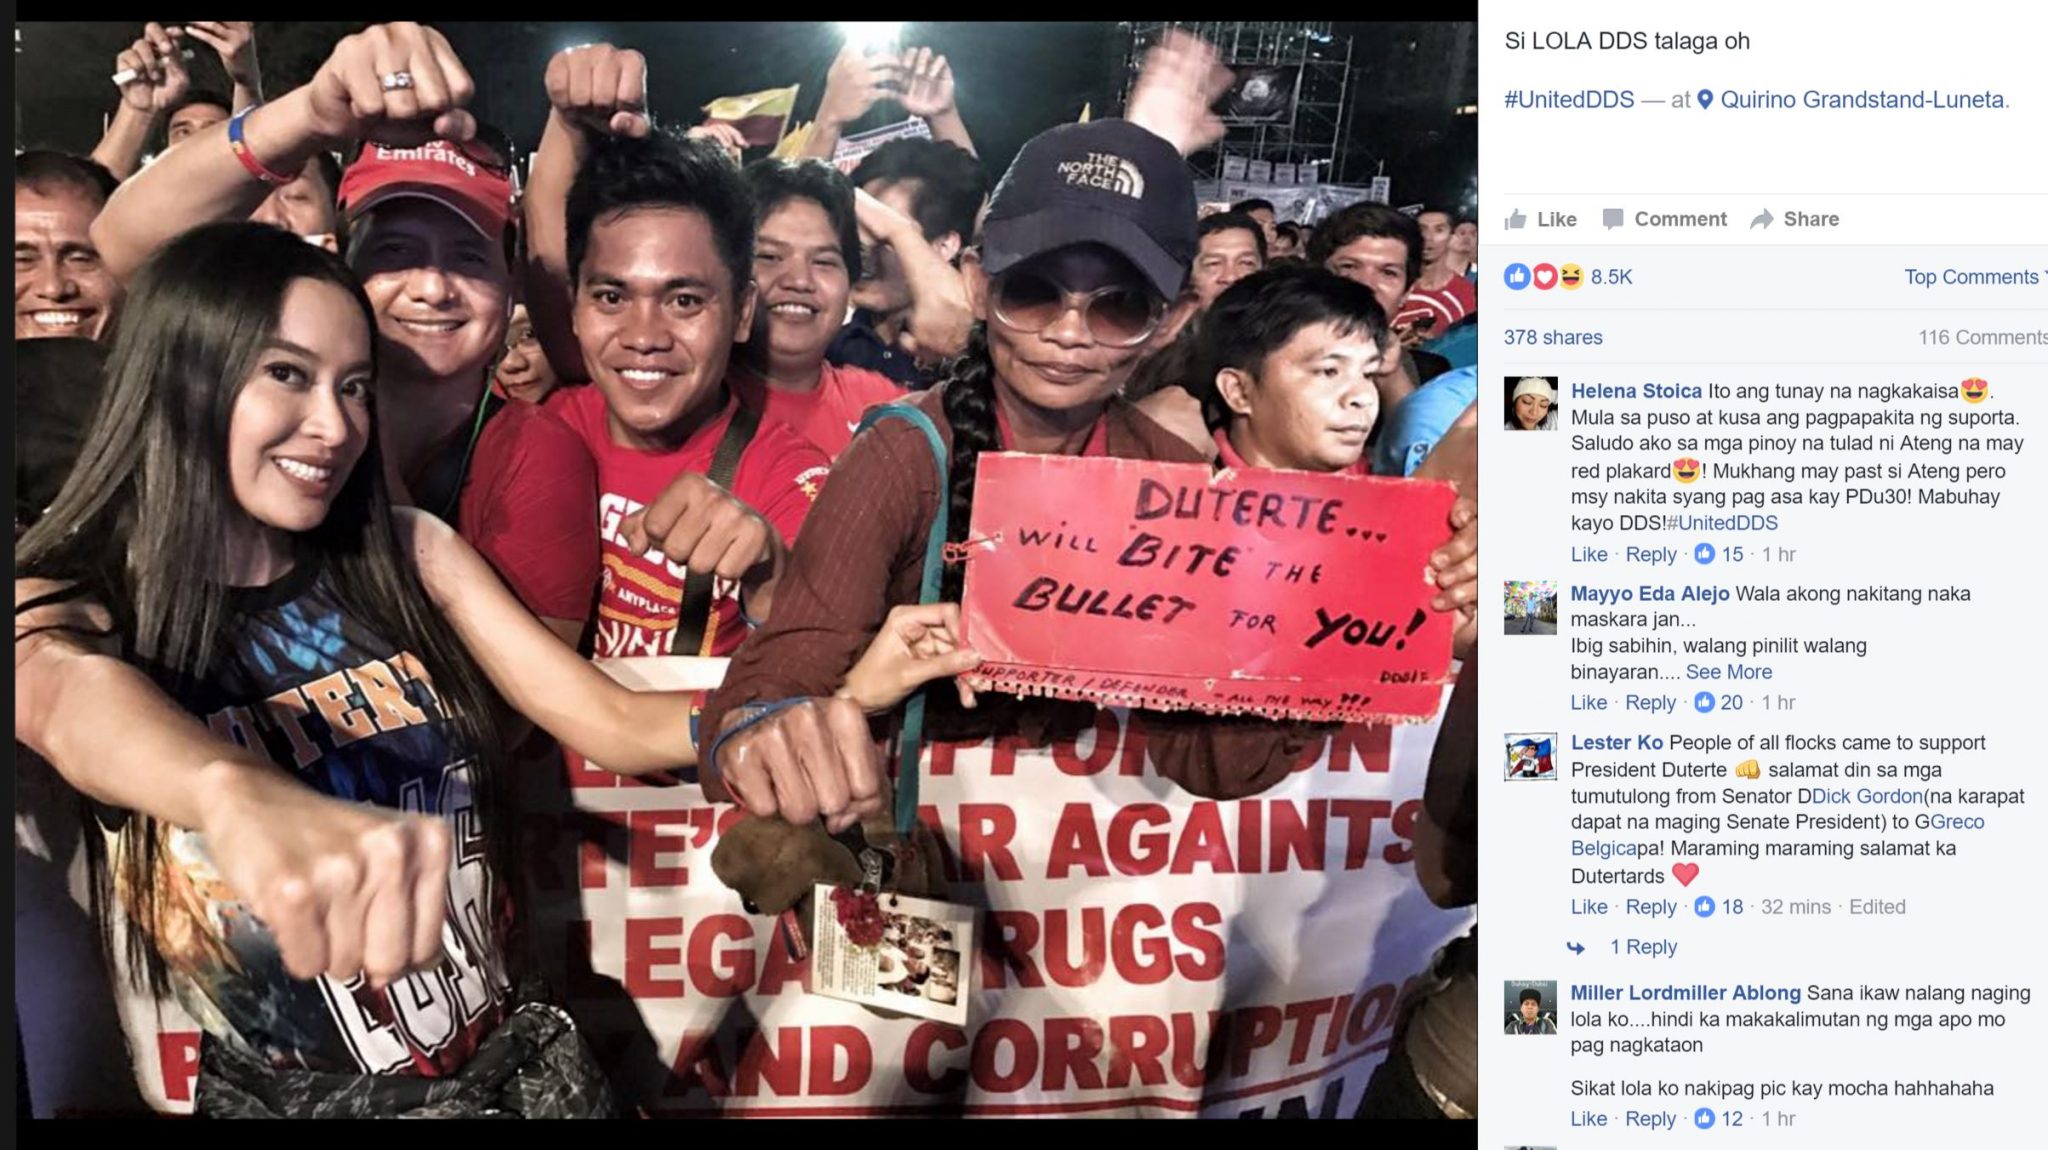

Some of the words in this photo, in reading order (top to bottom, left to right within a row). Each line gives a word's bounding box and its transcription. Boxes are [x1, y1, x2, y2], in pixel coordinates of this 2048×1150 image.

[1505, 31, 1525, 50] Si
[1533, 31, 1592, 50] LOLA
[1600, 31, 1648, 50] DDS
[1654, 31, 1718, 55] talaga
[1725, 31, 1750, 50] oh
[1505, 90, 1634, 108] #UnitedDDS
[1672, 91, 1690, 108] at
[1721, 90, 1796, 109] Quirino
[1803, 90, 2009, 108] Grandstand-Luneta.
[376, 146, 476, 176] Emirates
[1087, 152, 1119, 167] THE
[1057, 161, 1116, 179] NORTH
[1066, 174, 1112, 191] FACE
[1538, 212, 1577, 227] Like
[1635, 211, 1728, 226] Comment
[1785, 211, 1839, 226] Share
[1591, 269, 1632, 285] 8.5K
[1905, 269, 1937, 288] Top
[1943, 269, 2039, 285] Comments
[1504, 329, 1538, 345] 378
[1543, 329, 1603, 345] shares
[1921, 330, 1950, 344] 116
[1956, 330, 2048, 344] Comments
[1572, 383, 1636, 399] Helena
[1643, 383, 1702, 399] Stoica
[1709, 383, 1731, 399] Ito
[1736, 386, 1769, 403] ang
[1775, 384, 1824, 403] tunay
[1830, 386, 1852, 399] na
[1572, 435, 1634, 451] Saludo
[1639, 435, 1672, 451] ako
[1677, 438, 1698, 451] sa
[1704, 438, 1742, 455] mga
[1749, 435, 1797, 455] pinoy
[1803, 438, 1824, 451] na
[1830, 435, 1873, 451] tulad
[1880, 435, 1894, 450] ni
[1900, 435, 1952, 455] Ateng
[1959, 438, 1980, 451] na
[1986, 438, 2024, 455] may
[1572, 463, 1600, 479] red
[1714, 463, 1795, 483] Mukhang
[1801, 466, 1839, 483] may
[1845, 464, 1882, 483] past
[1888, 463, 1902, 479] si
[1907, 463, 1960, 483] Ateng
[1966, 466, 2006, 483] pero
[1134, 478, 1387, 543] DUTERTE...
[1572, 515, 1614, 535] kayo
[1572, 546, 1608, 562] Like
[1627, 546, 1677, 566] Reply
[1722, 547, 1744, 562] 15
[1779, 547, 1796, 562] hr
[1265, 560, 1324, 584] THE
[1012, 577, 1198, 624] BULLET
[1229, 609, 1277, 634] FOR
[1571, 585, 1633, 606] Mayyo
[1639, 585, 1675, 601] Eda
[1681, 585, 1730, 606] Alejo
[1735, 585, 1780, 602] Wala
[1786, 586, 1840, 606] akong
[1847, 585, 1922, 606] nakitang
[1928, 586, 1971, 602] naka
[1571, 611, 1647, 627] maskara
[1652, 611, 1696, 631] jan...
[1572, 637, 1603, 658] Ibig
[1609, 637, 1677, 655] sabihin,
[1683, 637, 1746, 658] walang
[1753, 637, 1798, 657] pinilit
[1803, 637, 1867, 658] walang
[971, 663, 1076, 686] SUPPORTER
[1099, 677, 1190, 698] DEFENDER
[1686, 664, 1722, 680] See
[1728, 664, 1773, 680] More
[1228, 693, 1254, 704] ALL
[1572, 694, 1608, 710] Like
[1626, 694, 1677, 714] Reply
[1720, 695, 1743, 710] 20
[1778, 695, 1796, 710] hr
[1572, 734, 1632, 750] Lester
[1638, 734, 1664, 750] Ko
[1670, 734, 1732, 754] People
[1737, 734, 1755, 750] of
[1760, 734, 1779, 750] all
[1785, 734, 1836, 750] flocks
[1842, 738, 1891, 750] came
[1897, 735, 1914, 750] to
[1919, 735, 1986, 754] support
[1571, 788, 1670, 808] tumutulong
[1676, 788, 1716, 804] from
[1722, 788, 1792, 804] Senator
[1798, 788, 1851, 804] DDick
[1857, 788, 1952, 808] Gordon(na
[1959, 788, 2025, 808] karapat
[918, 803, 1022, 882] AR
[1046, 798, 1415, 880] AGAINTS
[1572, 868, 1665, 884] Dutertards
[1572, 899, 1608, 914] Like
[1627, 899, 1678, 919] Reply
[1723, 899, 1744, 914] 18
[1762, 899, 1783, 914] 32
[1790, 899, 1832, 914] mins
[1851, 899, 1906, 914] Edited
[982, 902, 1227, 989] RUGS
[1627, 939, 1678, 959] Reply
[1571, 985, 1624, 1000] Miller
[1630, 985, 1728, 1000] Lordmiller
[1732, 985, 1801, 1005] Ablong
[1807, 985, 1854, 1000] Sana
[1860, 985, 1900, 1000] ikaw
[1906, 985, 1965, 1005] nalang
[1971, 985, 2030, 1005] naging
[664, 1025, 873, 1097] AND
[1571, 1080, 1616, 1096] Sikat
[1621, 1080, 1652, 1096] lola
[1659, 1080, 1679, 1096] ko
[1685, 1080, 1754, 1100] nakipag
[1761, 1080, 1786, 1100] pic
[1792, 1080, 1823, 1100] kay
[1829, 1080, 1888, 1096] mocha
[1895, 1080, 1994, 1096] hahhahaha
[1572, 1111, 1608, 1126] Like
[1627, 1111, 1677, 1131] Reply
[1722, 1111, 1743, 1126] 12
[1778, 1111, 1796, 1126] hr
